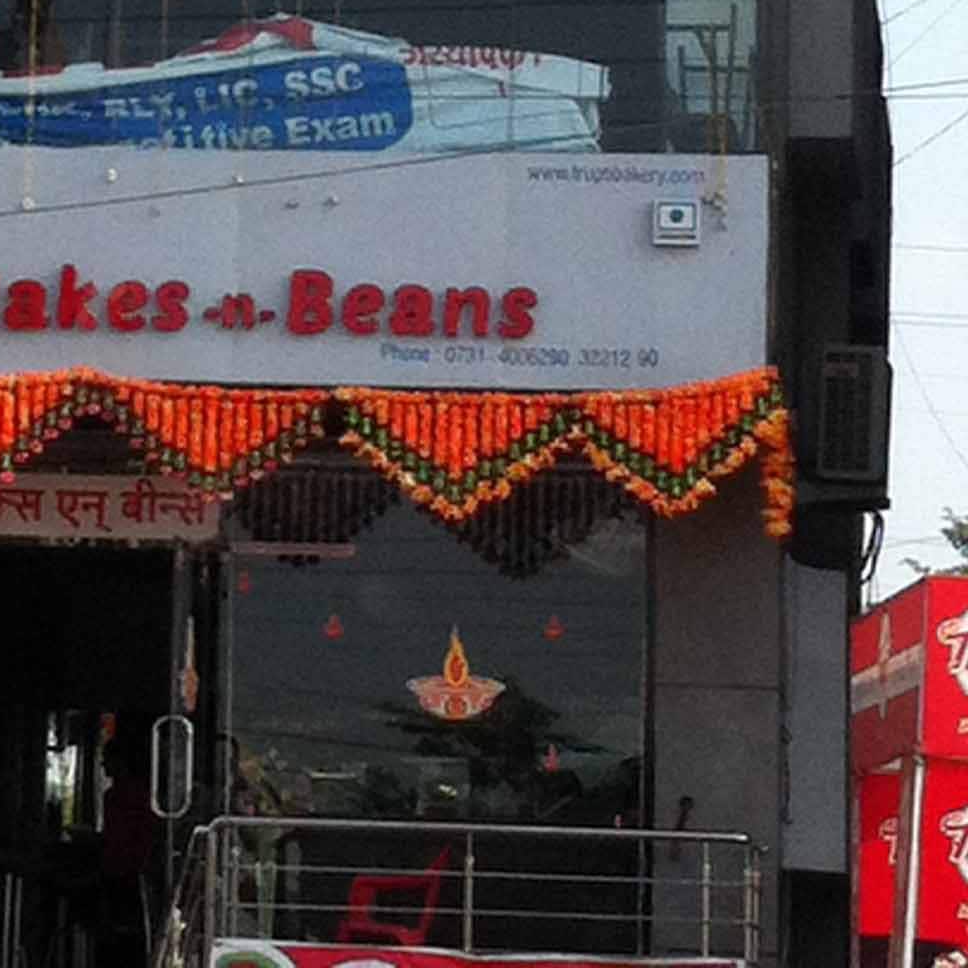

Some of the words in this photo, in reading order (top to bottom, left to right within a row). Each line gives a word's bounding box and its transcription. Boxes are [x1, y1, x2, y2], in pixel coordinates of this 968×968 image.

[285, 62, 363, 99] SSC
[285, 109, 395, 145] Exam
[286, 269, 538, 339] Beans
